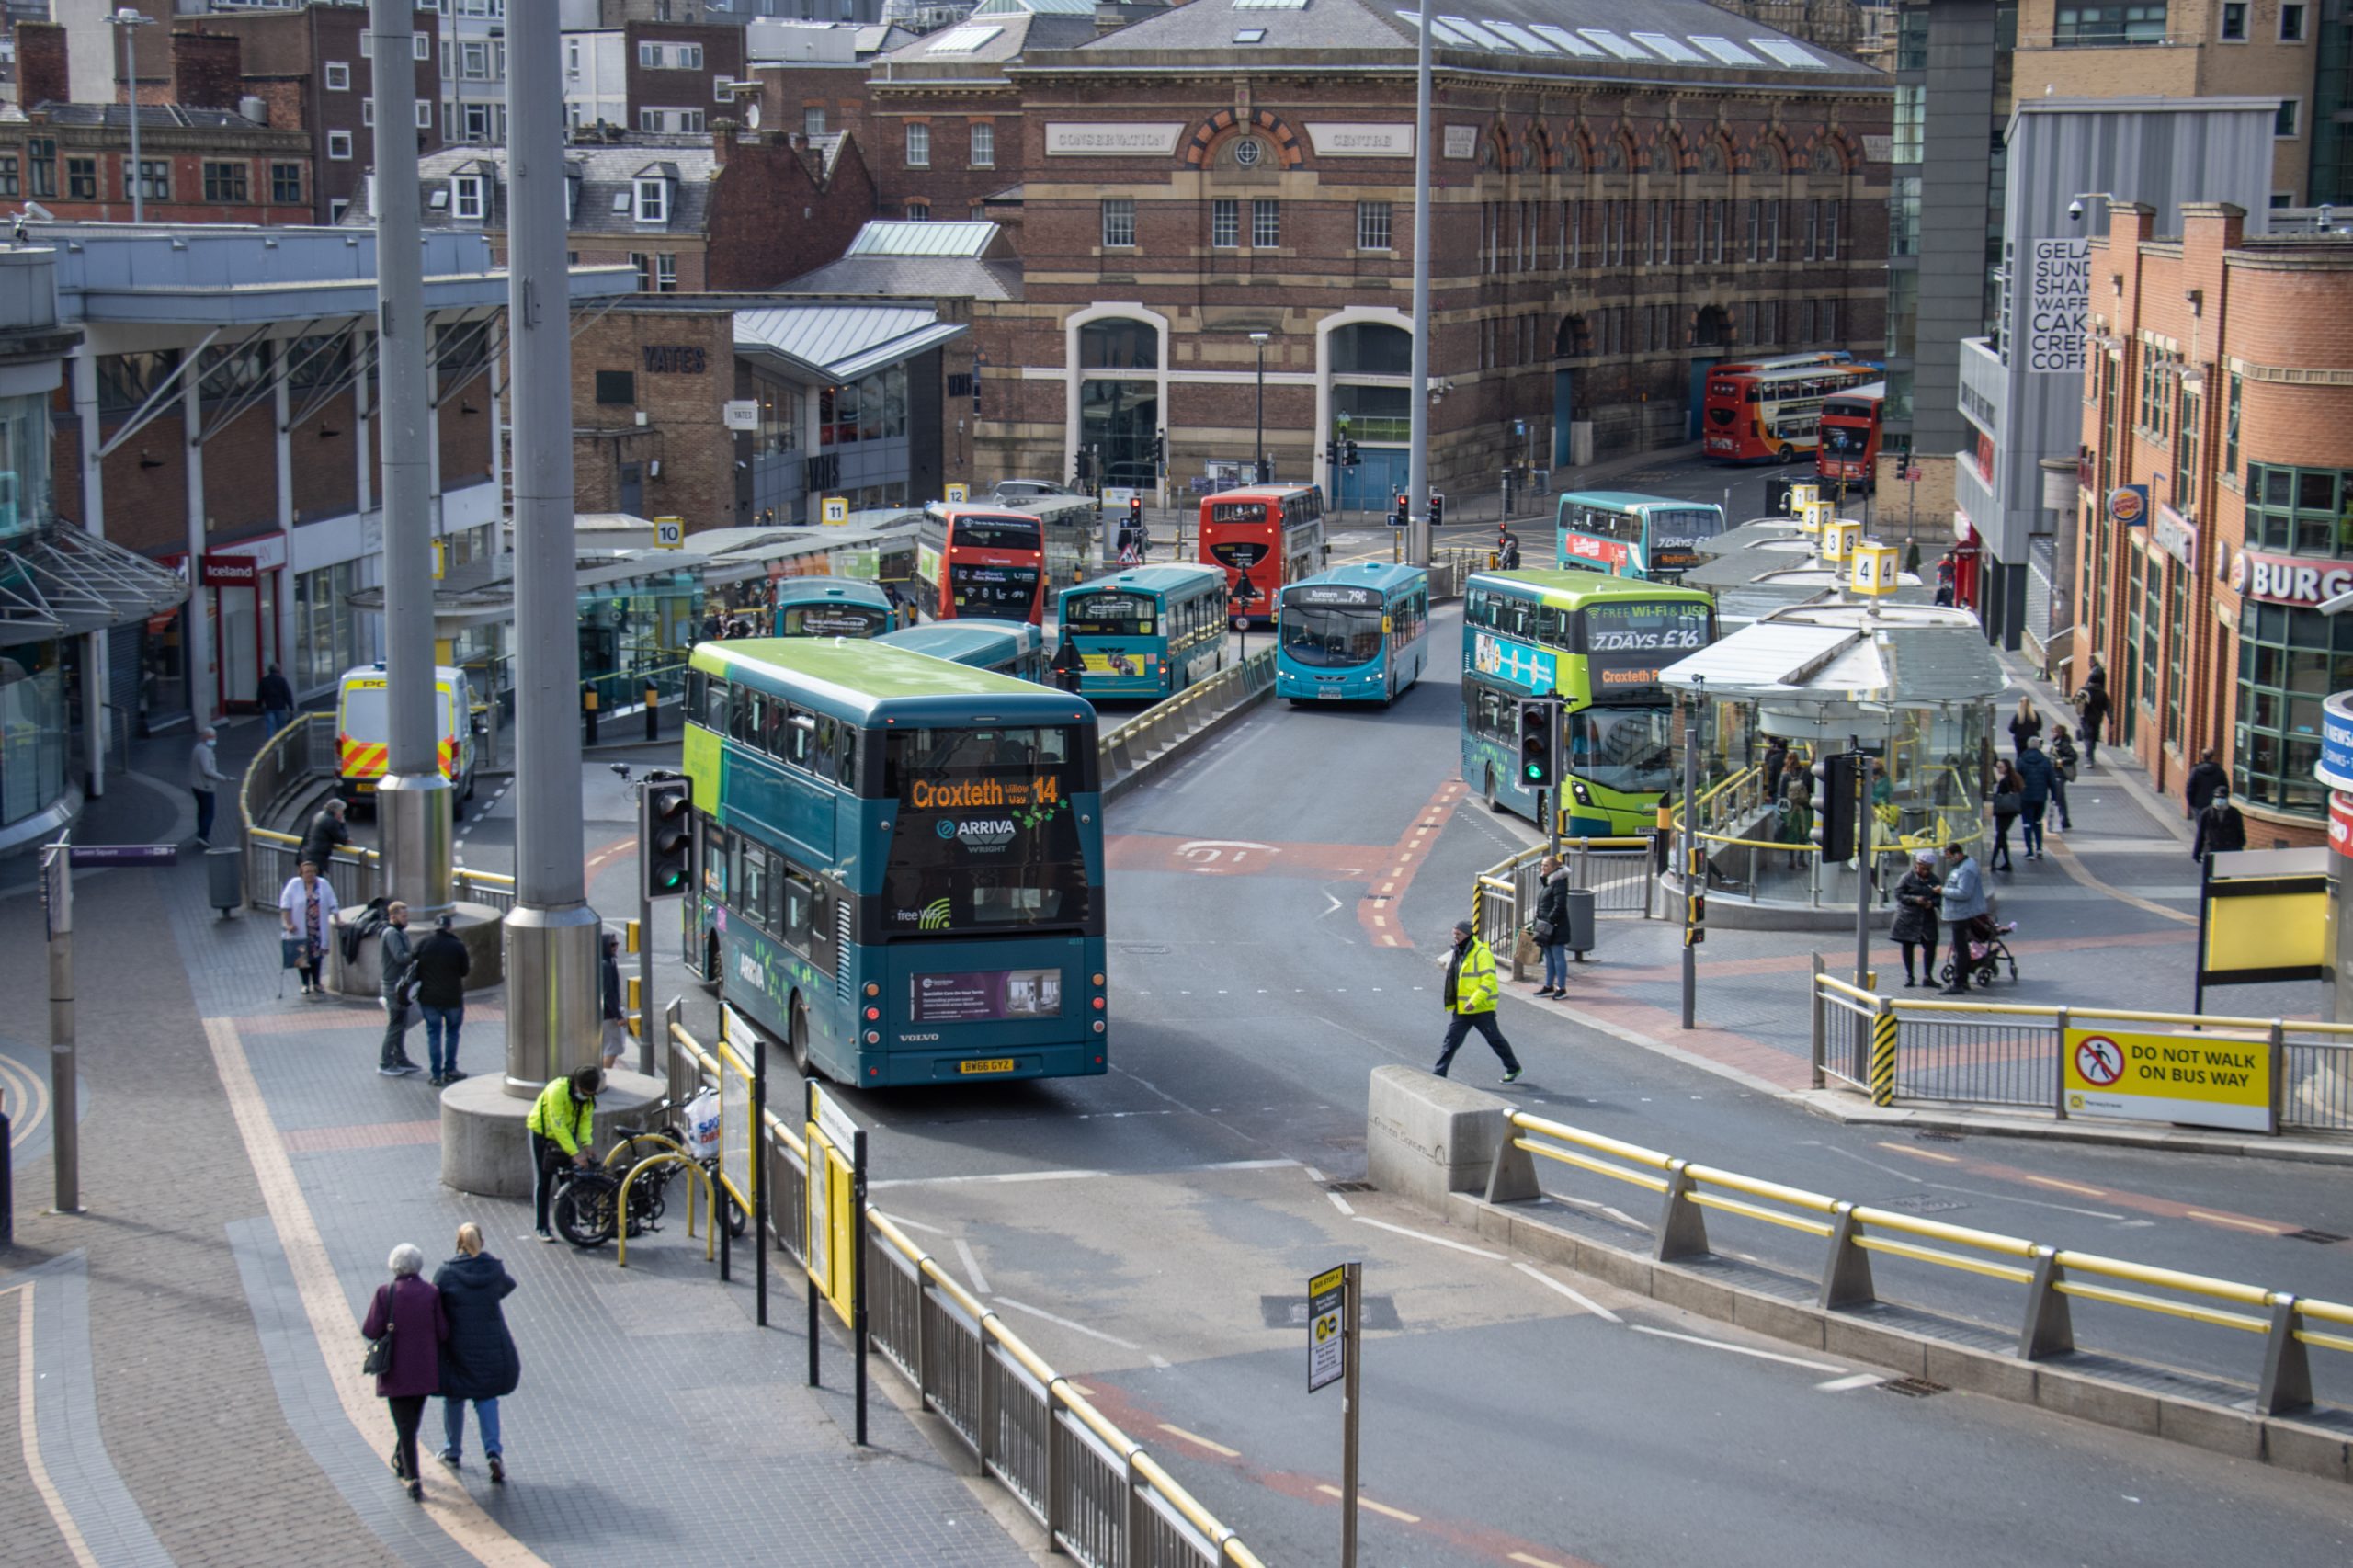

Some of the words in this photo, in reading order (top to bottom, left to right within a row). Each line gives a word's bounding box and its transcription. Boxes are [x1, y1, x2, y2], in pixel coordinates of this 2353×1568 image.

[1059, 134, 1165, 146] CONSERVATION
[1334, 134, 1392, 147] CENTRE
[643, 346, 705, 373] YATES
[733, 411, 753, 420] YATES
[950, 492, 962, 502] 12
[830, 506, 842, 518] 11
[1809, 510, 1815, 524] 2
[1824, 511, 1829, 524] 2
[659, 526, 678, 540] 10
[1665, 537, 1693, 548] DAYS
[1830, 534, 1836, 551] 3
[1847, 535, 1854, 551] 3
[207, 565, 253, 577] Iceland
[1860, 561, 1869, 581] 4
[1883, 561, 1891, 581] 4
[2253, 561, 2353, 602] BURG
[1312, 590, 1338, 599] Runcorn
[1347, 590, 1367, 603] 79C
[1603, 608, 1630, 618] FREE
[1632, 606, 1667, 617] Wi-Fi
[1670, 607, 1678, 617] &
[1682, 605, 1709, 617] USB
[1593, 635, 1606, 651] 7
[1608, 634, 1657, 651] DAYS
[1662, 630, 1699, 649] £16
[1602, 670, 1649, 683] Croxteth
[913, 778, 1003, 808] Croxteth
[1005, 784, 1029, 794] Willow
[1032, 776, 1058, 804] 14
[1008, 795, 1026, 804] Way
[958, 820, 1016, 835] ARRIVA
[96, 848, 118, 857] Square
[897, 910, 918, 920] free
[740, 952, 765, 991] ARRIVA
[899, 1033, 939, 1042] VOLVO
[2131, 1045, 2157, 1060] DO
[2164, 1049, 2200, 1063] NOT
[2204, 1051, 2256, 1069] WALK
[965, 1062, 989, 1072] BW66
[991, 1060, 1010, 1071] GYZ
[2140, 1065, 2165, 1080] ON
[2172, 1069, 2206, 1084] BUS
[2211, 1073, 2249, 1087] WAY
[1324, 1275, 1335, 1286] STOP
